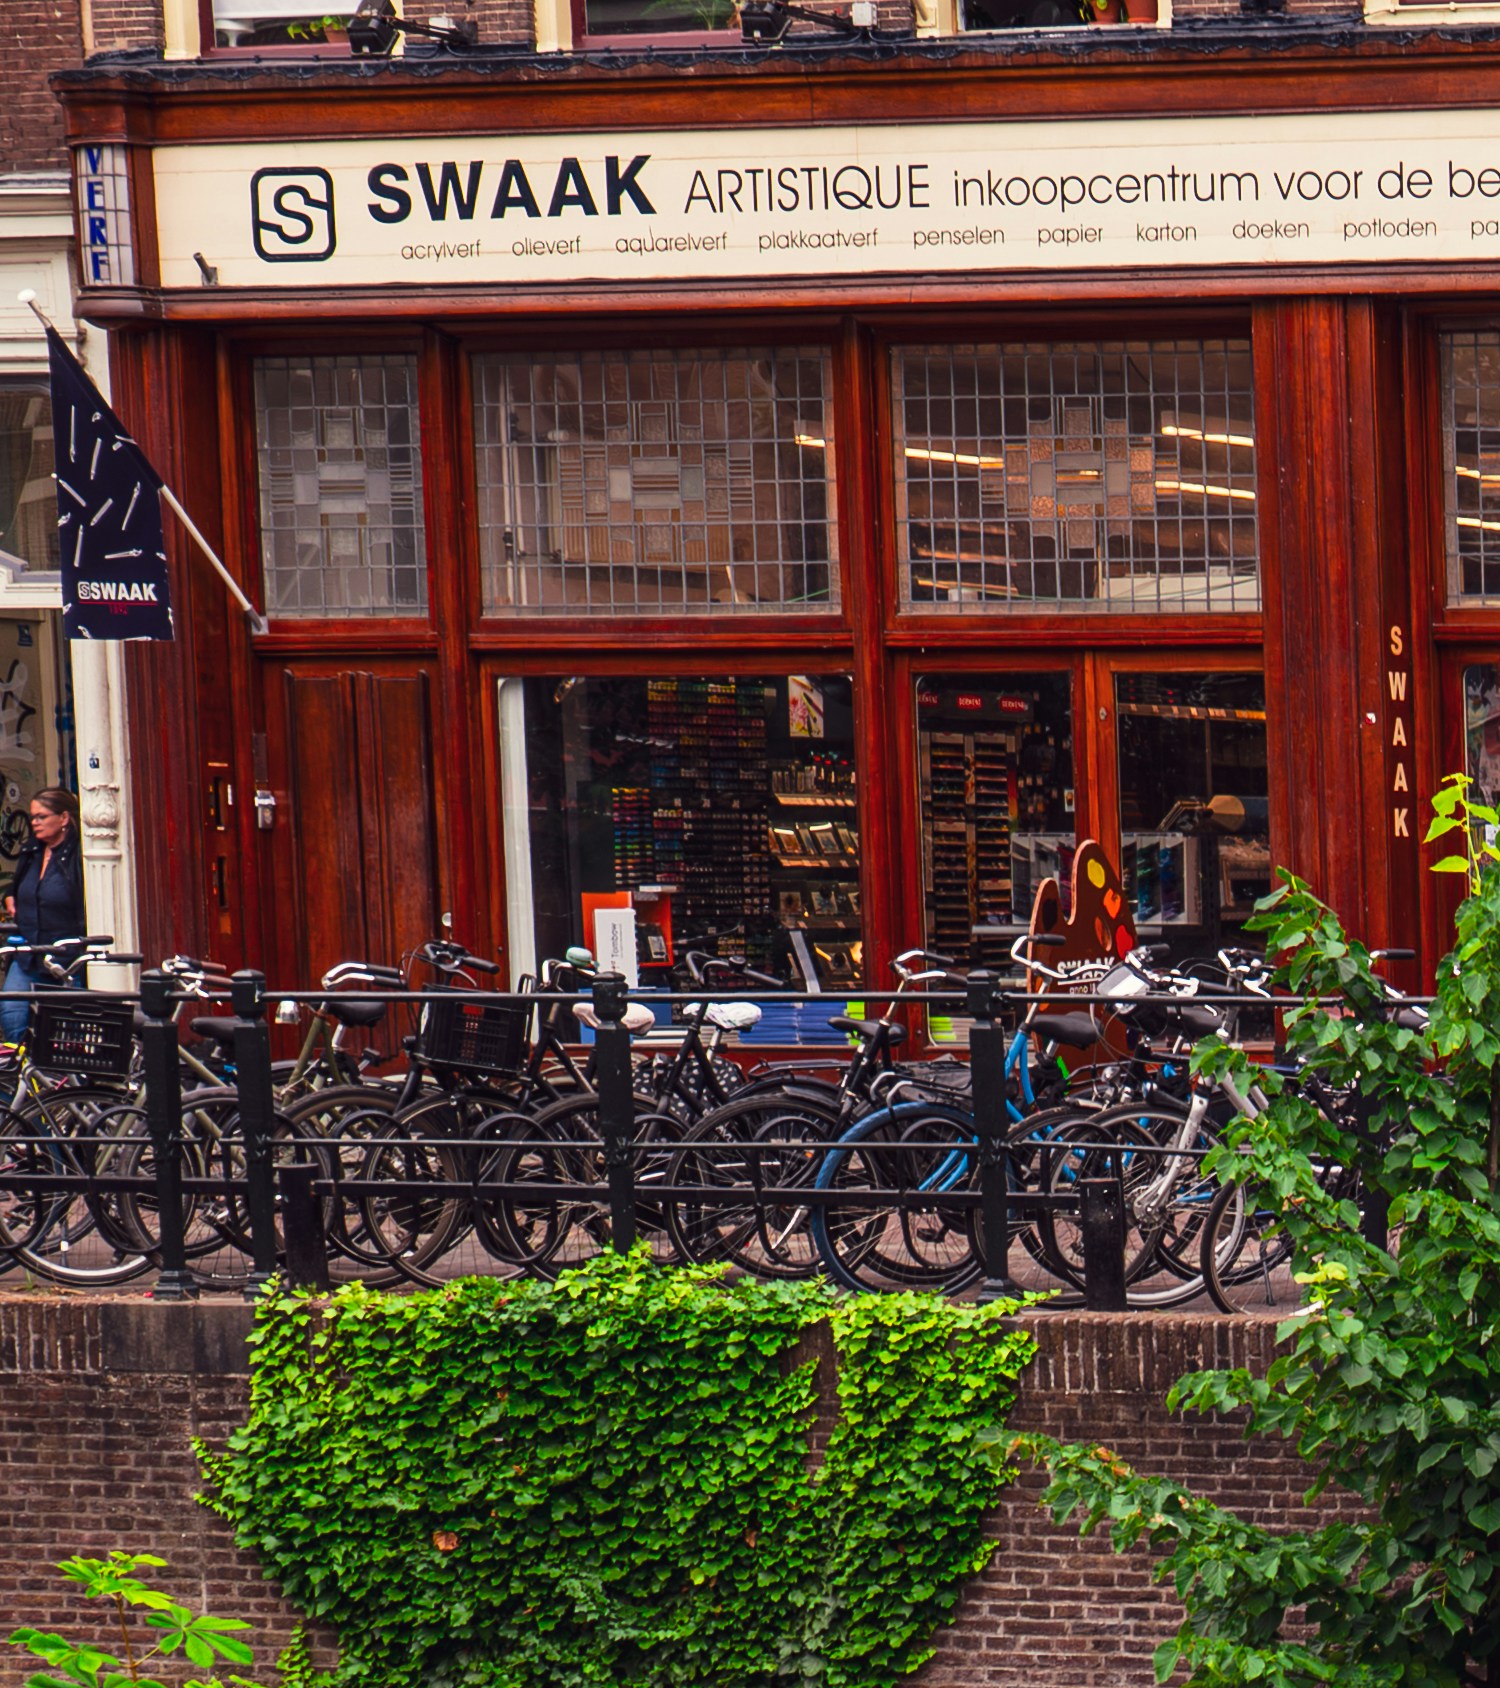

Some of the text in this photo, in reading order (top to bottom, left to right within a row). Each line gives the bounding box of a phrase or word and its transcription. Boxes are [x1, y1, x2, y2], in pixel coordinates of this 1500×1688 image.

[86, 147, 110, 281] VERF
[367, 155, 656, 224] SWAAK
[685, 164, 930, 215] ARTISTIQUE
[954, 165, 1259, 212] inkoopcentrum
[1274, 168, 1364, 201] voor
[1377, 162, 1433, 199] de
[401, 237, 481, 262] acrylverf
[512, 235, 581, 257] olieverf
[615, 231, 727, 256] aquarelverf
[758, 227, 878, 252] plakkaatverf
[913, 225, 1005, 249] penselen
[1038, 224, 1103, 247] papier
[1136, 222, 1197, 242] karton
[1232, 219, 1309, 239] doeken
[1344, 217, 1437, 241] potloden
[90, 582, 158, 601] SWAAK
[1388, 625, 1410, 837] SWAAK
